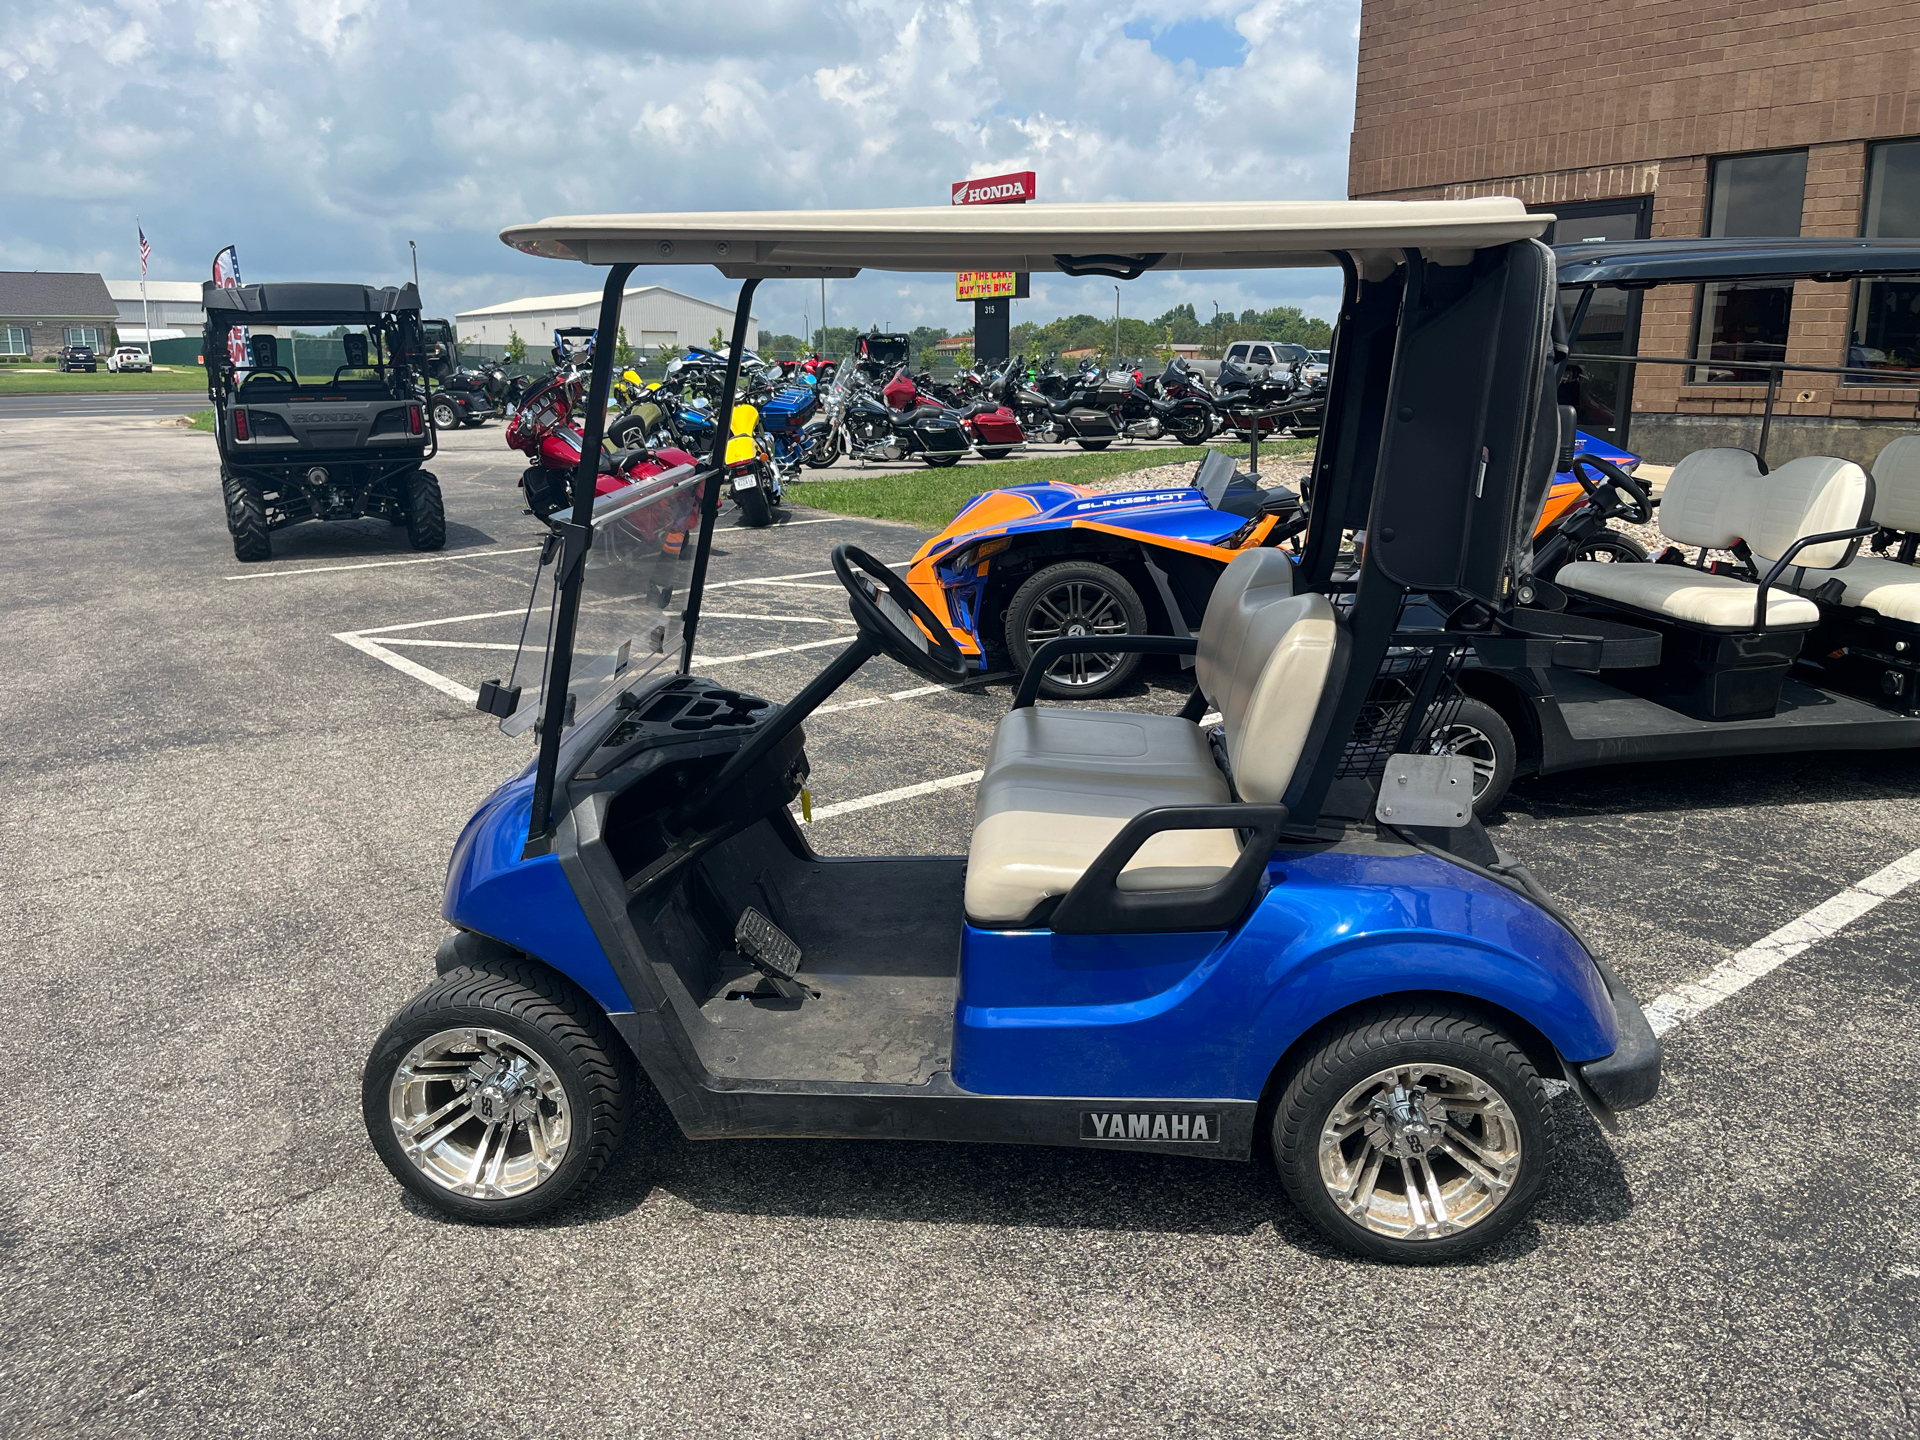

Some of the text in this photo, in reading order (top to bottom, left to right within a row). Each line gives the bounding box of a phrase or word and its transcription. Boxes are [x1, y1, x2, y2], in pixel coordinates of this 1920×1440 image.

[968, 182, 1025, 202] HONDA
[959, 272, 1013, 282] EAT THE CAKE
[959, 282, 1013, 295] BUY THE BIKE
[984, 305, 995, 314] 315
[292, 412, 370, 423] HONDA
[1077, 492, 1187, 510] SLINGSHOT
[1090, 1113, 1210, 1140] YAMAHA
